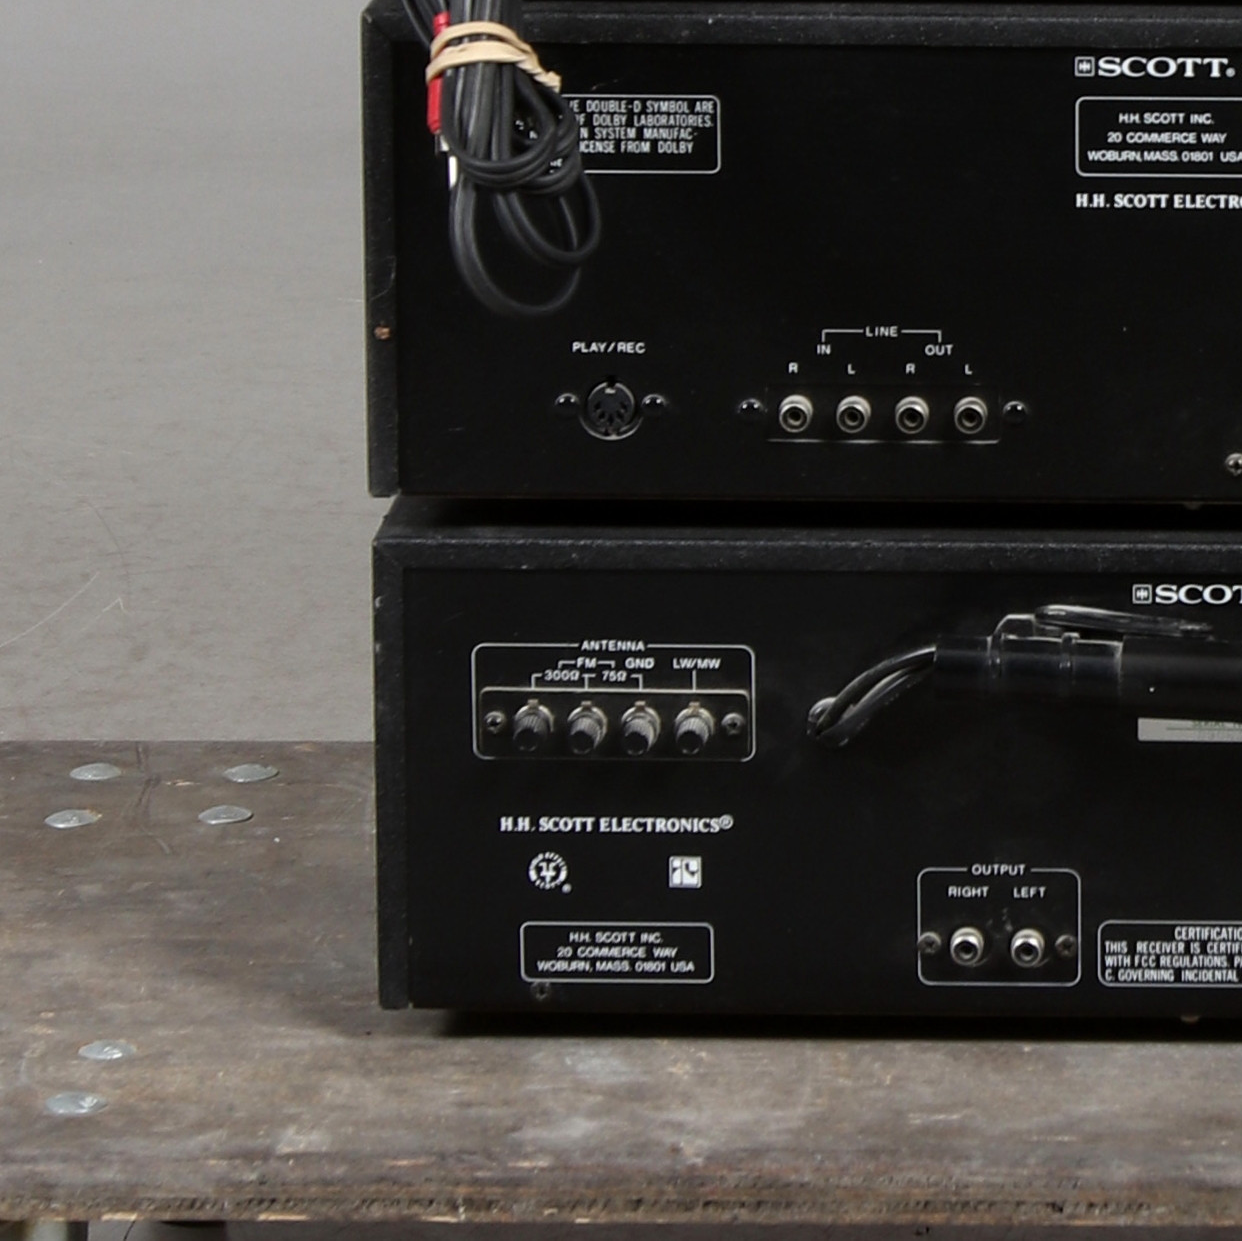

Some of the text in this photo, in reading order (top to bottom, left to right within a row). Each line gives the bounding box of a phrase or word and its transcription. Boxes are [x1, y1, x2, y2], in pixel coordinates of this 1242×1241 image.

[585, 99, 715, 114] DOUBLE-D SYMBOL ARE
[592, 113, 712, 128] DOLBY LABORATORIES.
[594, 126, 700, 141] SYSTEM MANUFAC-
[1107, 131, 1228, 144] 20 COMMERCE WAY
[620, 140, 651, 154] FROM
[657, 140, 694, 154] DOLBY
[1075, 193, 1110, 208] H.H.
[1113, 193, 1170, 209] SCOTT
[864, 325, 899, 338] LINE
[571, 341, 646, 354] PLAY/REC
[816, 343, 832, 355] IN
[924, 343, 954, 356] OUT
[788, 361, 799, 374] R
[847, 363, 856, 375] L
[905, 362, 916, 374] R
[964, 363, 973, 376] L
[580, 639, 645, 653] ANTENNA
[575, 656, 598, 670] FM
[624, 656, 655, 670] GND
[672, 657, 721, 672] LW/MW
[500, 816, 536, 832] H.H.
[538, 816, 596, 833] SCOTT
[971, 862, 1027, 877] OUTPUT
[947, 885, 989, 898] RIGHT
[1013, 886, 1046, 899] LEFT
[1104, 940, 1128, 957] THIS
[1135, 940, 1185, 957] RECEIVER
[1190, 941, 1204, 957] IS
